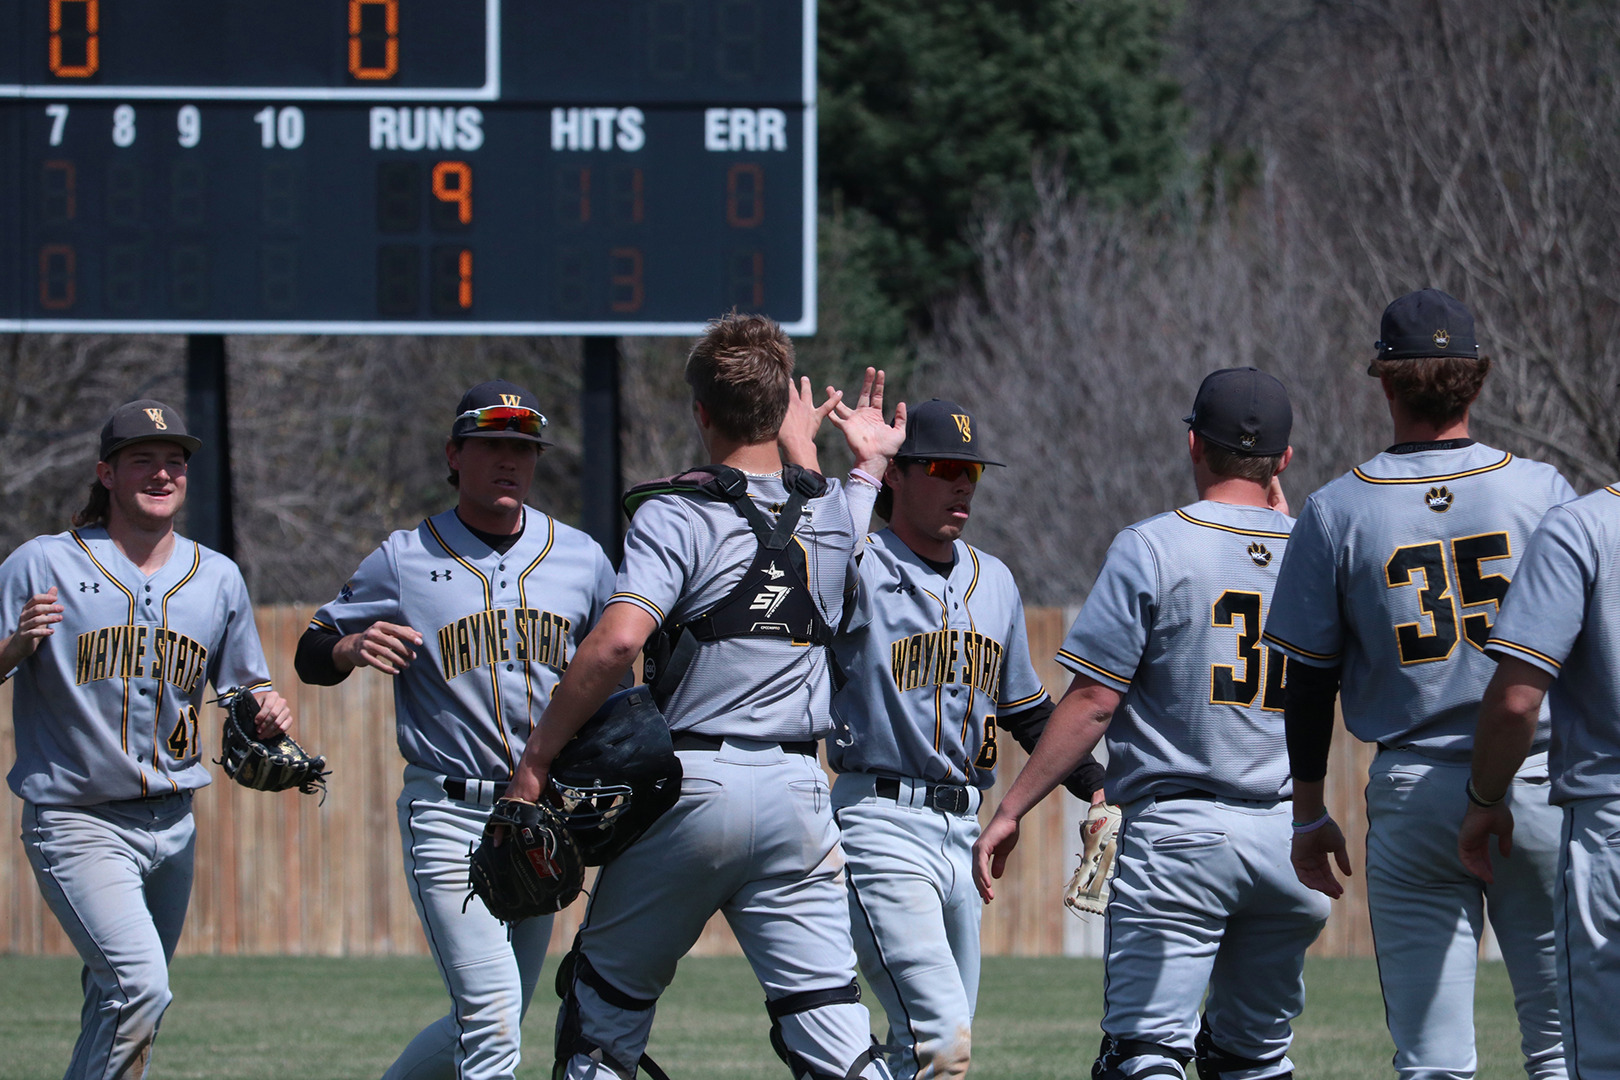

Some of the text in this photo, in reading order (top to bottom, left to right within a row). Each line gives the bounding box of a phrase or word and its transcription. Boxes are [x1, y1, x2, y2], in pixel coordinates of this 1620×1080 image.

[348, 0, 398, 80] 0
[45, 104, 788, 151] 7 8 9 10 RUNS HITS ERR
[432, 161, 472, 224] 9
[727, 163, 764, 228] 0
[39, 245, 76, 309] 0
[458, 249, 472, 308] 1
[611, 247, 644, 313] 3
[951, 414, 972, 443] WS
[1384, 531, 1512, 665] 35
[76, 625, 207, 695] WAYNE STATE
[438, 608, 511, 682] WAYNE
[891, 629, 959, 694] WAYNE
[167, 705, 199, 760] 41
[973, 714, 998, 770] 8
